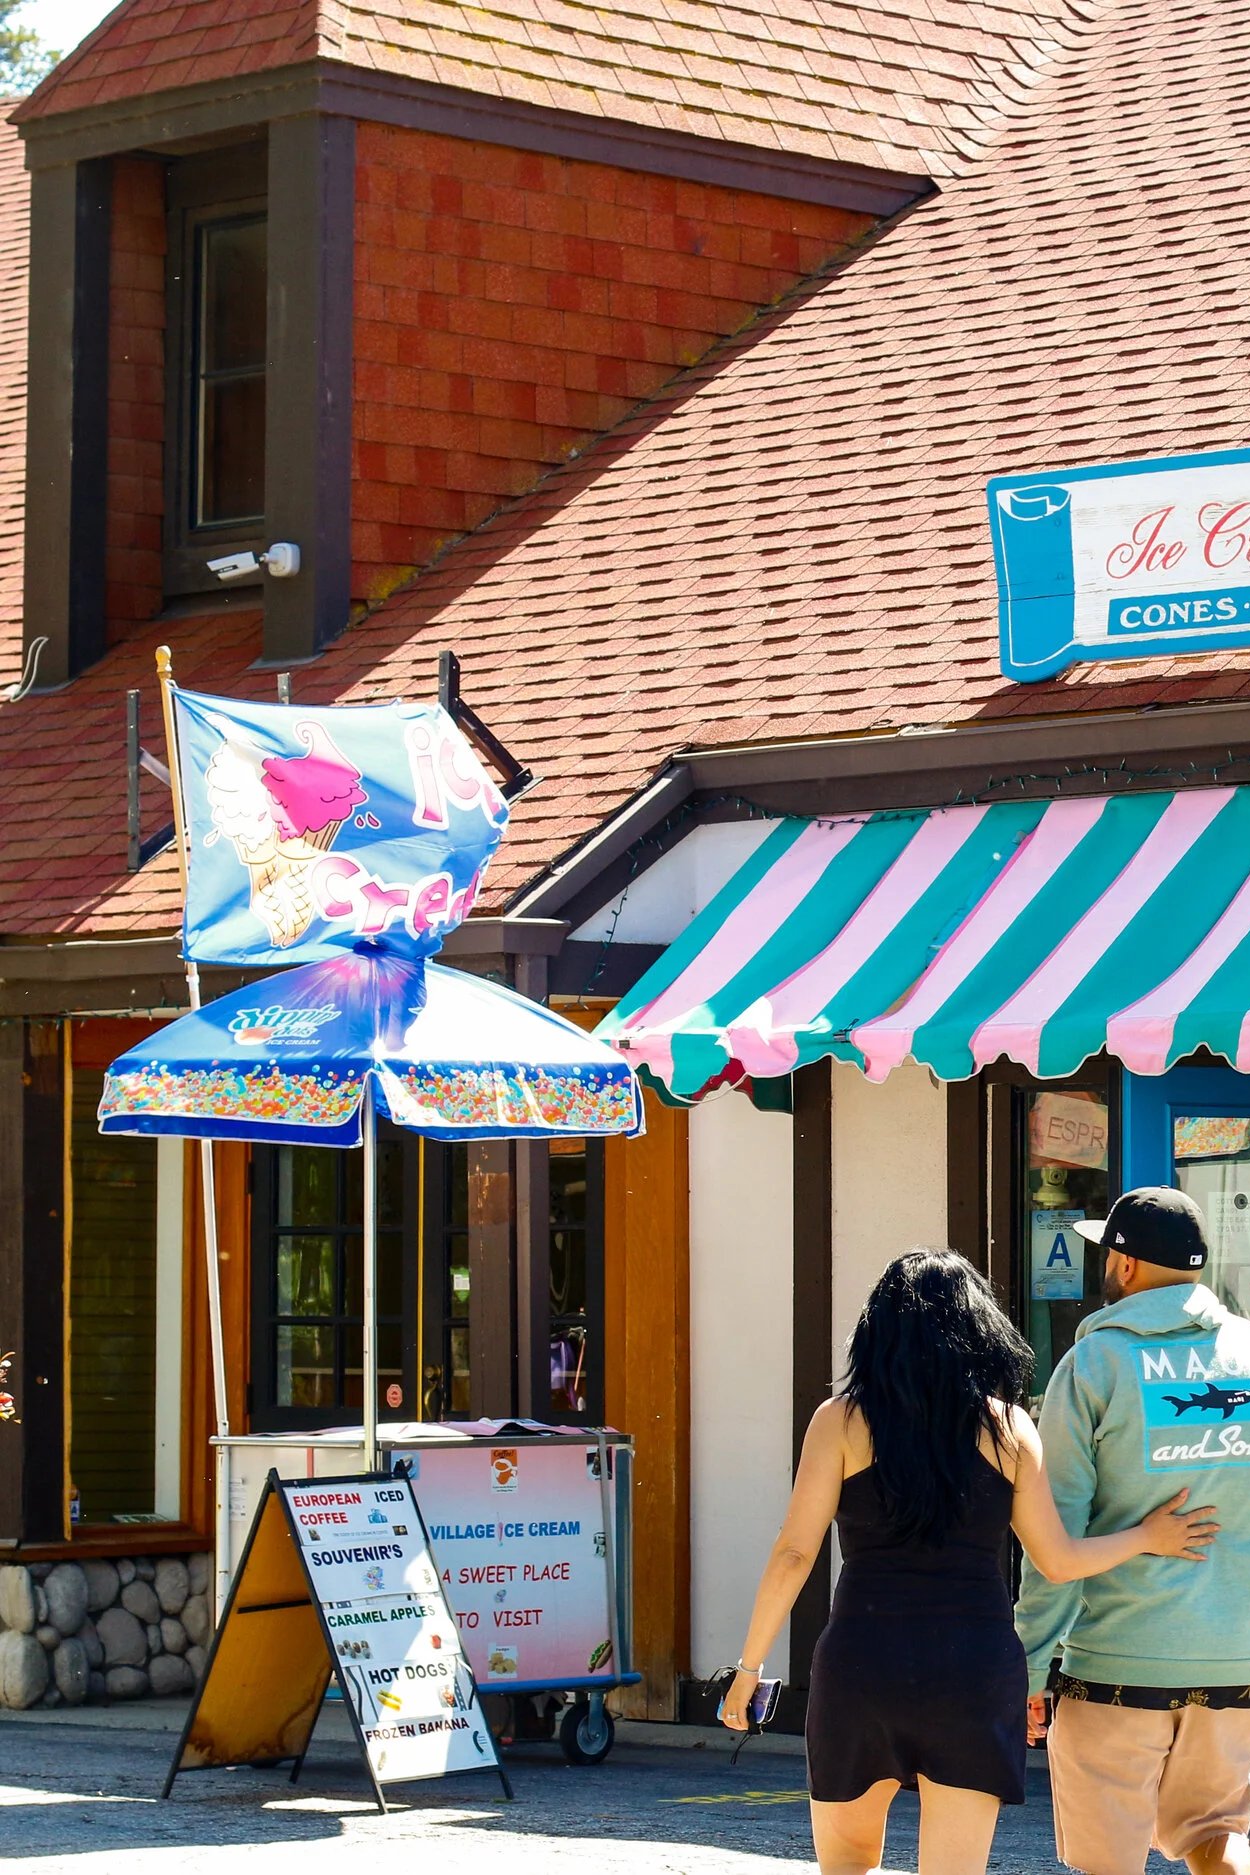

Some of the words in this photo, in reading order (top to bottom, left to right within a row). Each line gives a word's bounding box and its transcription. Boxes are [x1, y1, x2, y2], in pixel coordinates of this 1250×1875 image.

[1105, 504, 1188, 580] Ice
[1118, 596, 1238, 630] CONES
[1046, 1232, 1072, 1267] A
[293, 1493, 362, 1508] EUROPEAN
[374, 1490, 405, 1504] ICED
[300, 1512, 349, 1526] COFFEE
[430, 1524, 496, 1540] VILLAGE
[528, 1521, 581, 1537] CREAM
[311, 1544, 403, 1567] SOUVENIR'S
[442, 1568, 452, 1584] A
[458, 1565, 518, 1584] SWEET
[523, 1562, 571, 1581] PLACE
[327, 1610, 388, 1628] CARAMEL
[390, 1605, 436, 1621] APPLES
[456, 1612, 480, 1629] TO
[493, 1609, 543, 1627] VISIT
[368, 1667, 400, 1685] HOT
[404, 1662, 448, 1680] DOGS
[365, 1725, 416, 1743] FROZEN
[419, 1717, 470, 1736] BANANA
